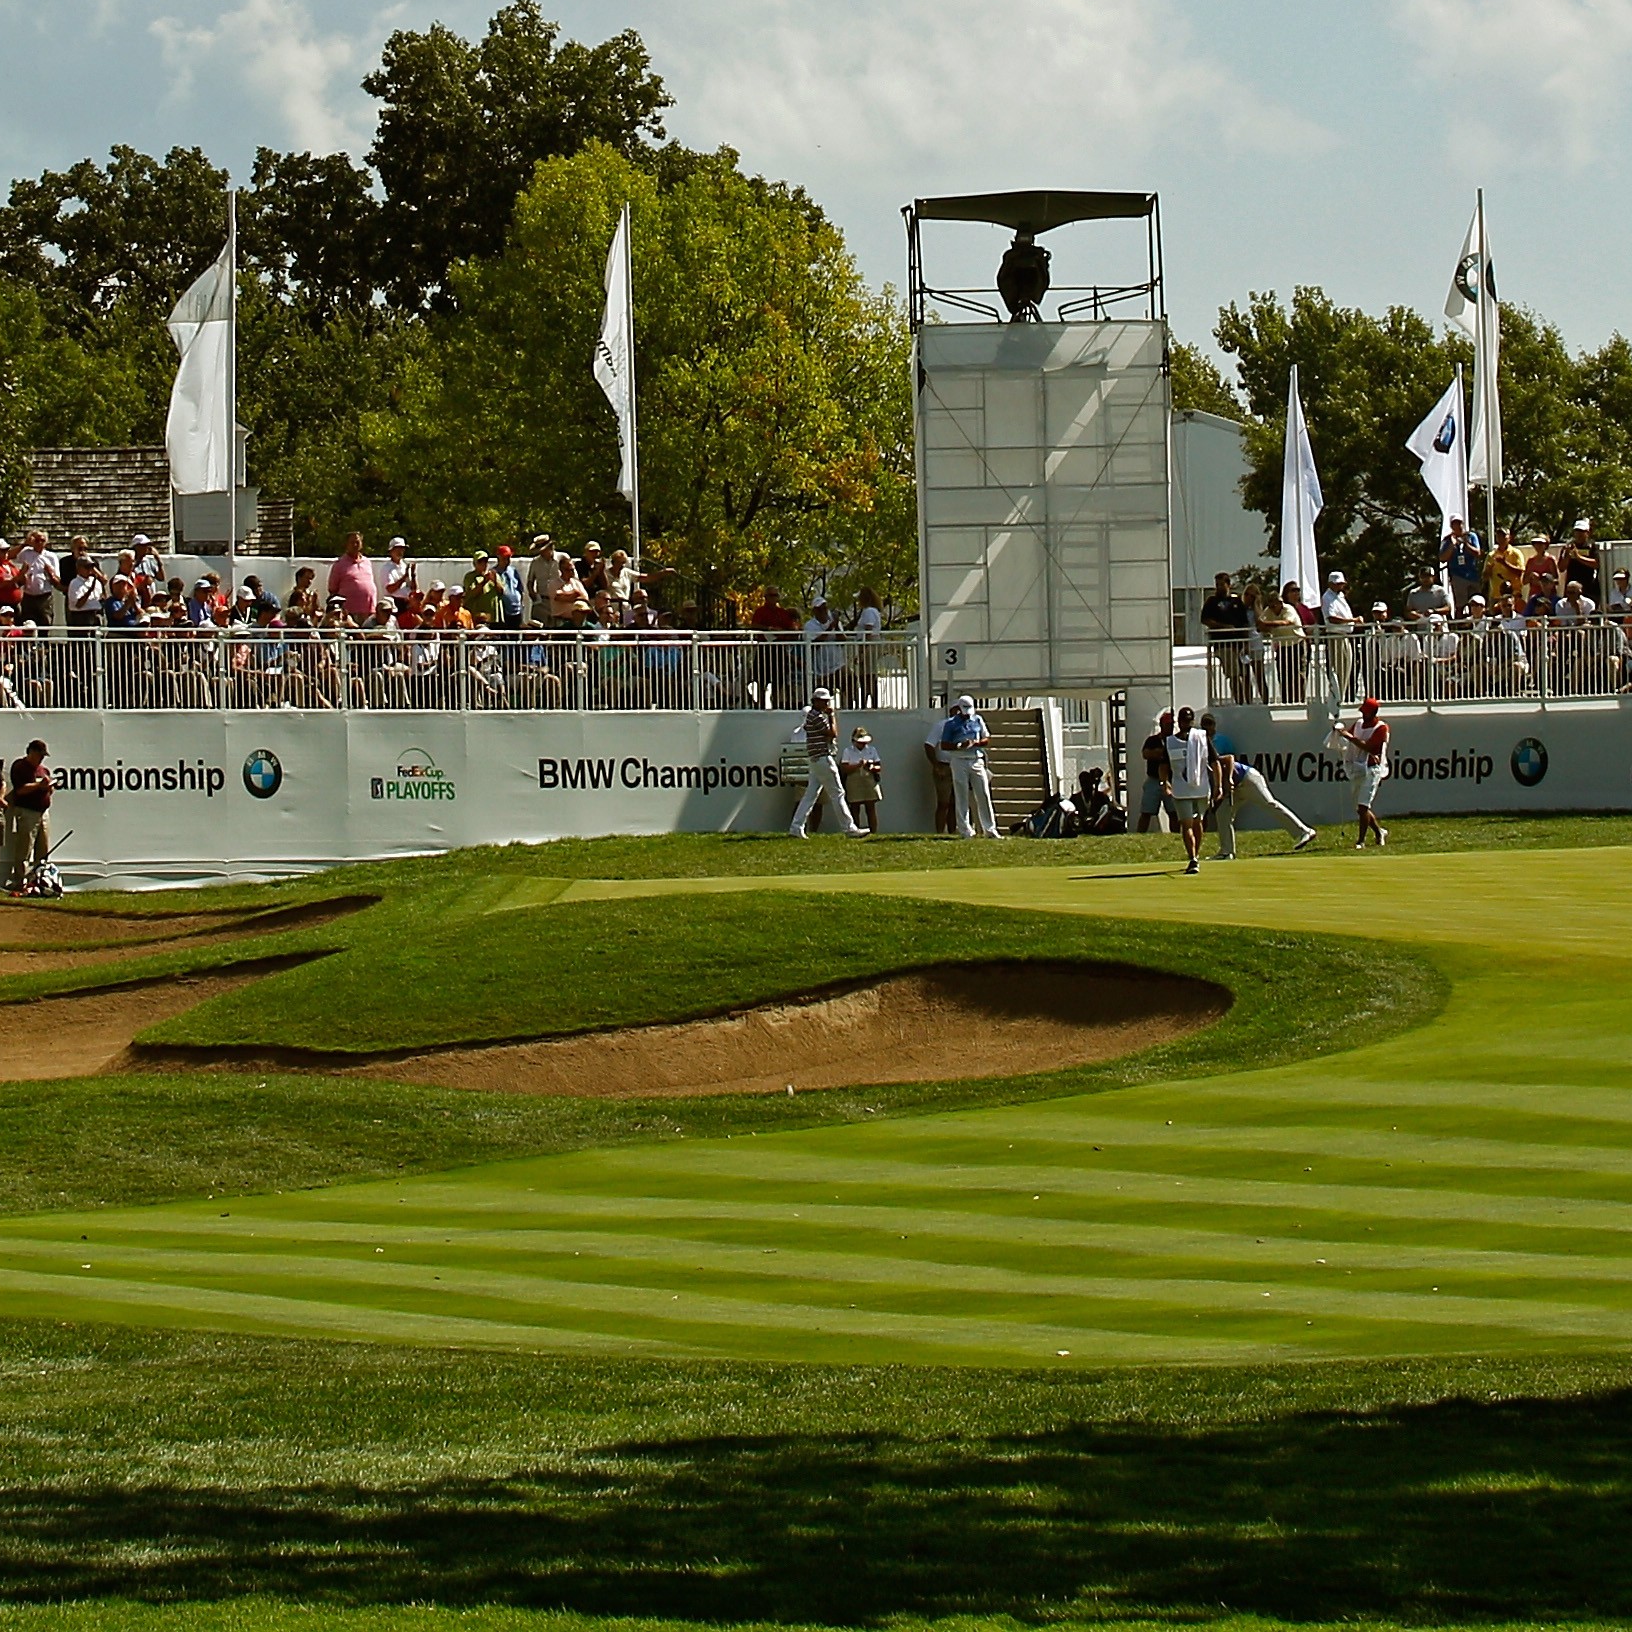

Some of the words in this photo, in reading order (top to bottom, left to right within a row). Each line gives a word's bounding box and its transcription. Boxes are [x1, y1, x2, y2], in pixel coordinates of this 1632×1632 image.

[945, 648, 958, 665] 3
[52, 758, 225, 798] ampionship
[538, 758, 616, 789] BMW
[620, 757, 795, 796] Champions
[1236, 752, 1292, 783] MW
[1297, 748, 1494, 787] Chaionship
[387, 781, 456, 800] PLAYOFFS
